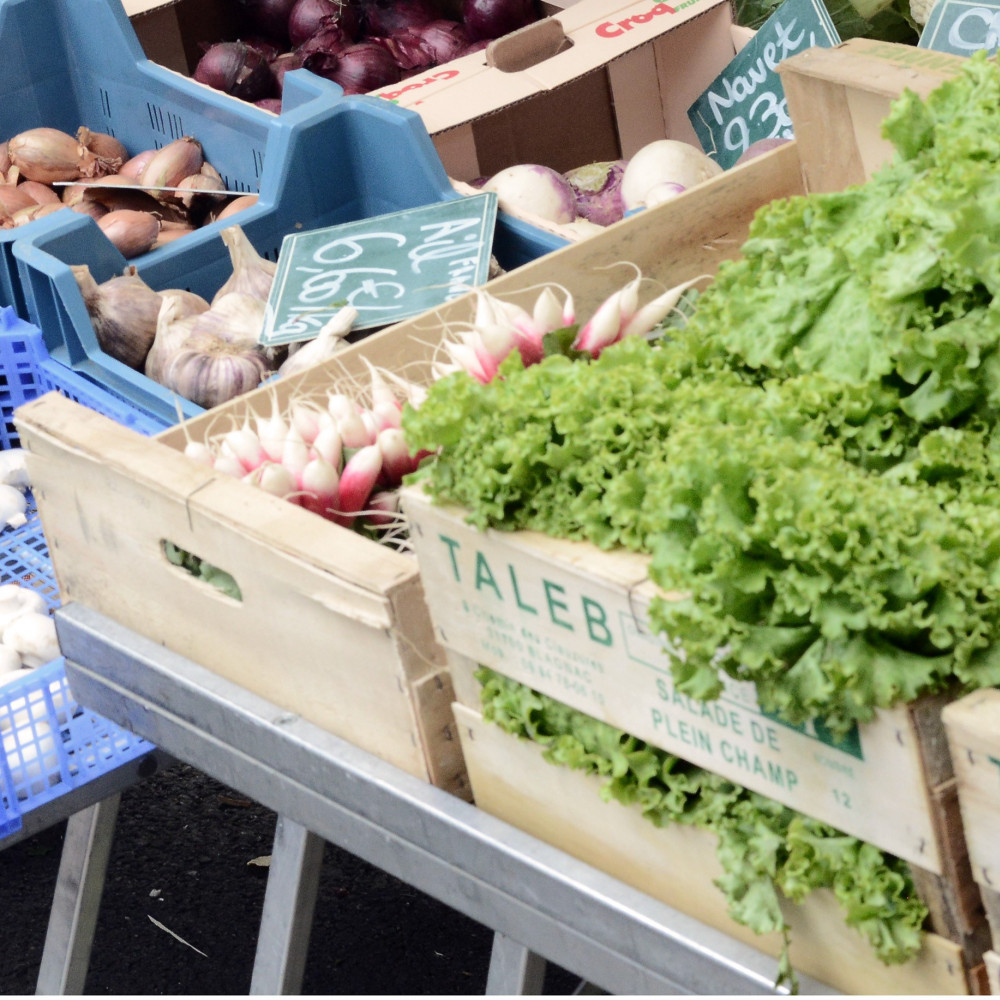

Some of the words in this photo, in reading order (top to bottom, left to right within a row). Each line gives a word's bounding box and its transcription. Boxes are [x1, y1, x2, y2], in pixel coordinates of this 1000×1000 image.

[595, 1, 678, 39] Croq
[708, 17, 806, 126] Navet
[438, 534, 614, 648] TALEB
[651, 708, 713, 754] PLEIN
[719, 740, 799, 792] CHAMP
[655, 678, 744, 736] SALADE
[750, 720, 781, 752] DE
[832, 788, 852, 809] 12
